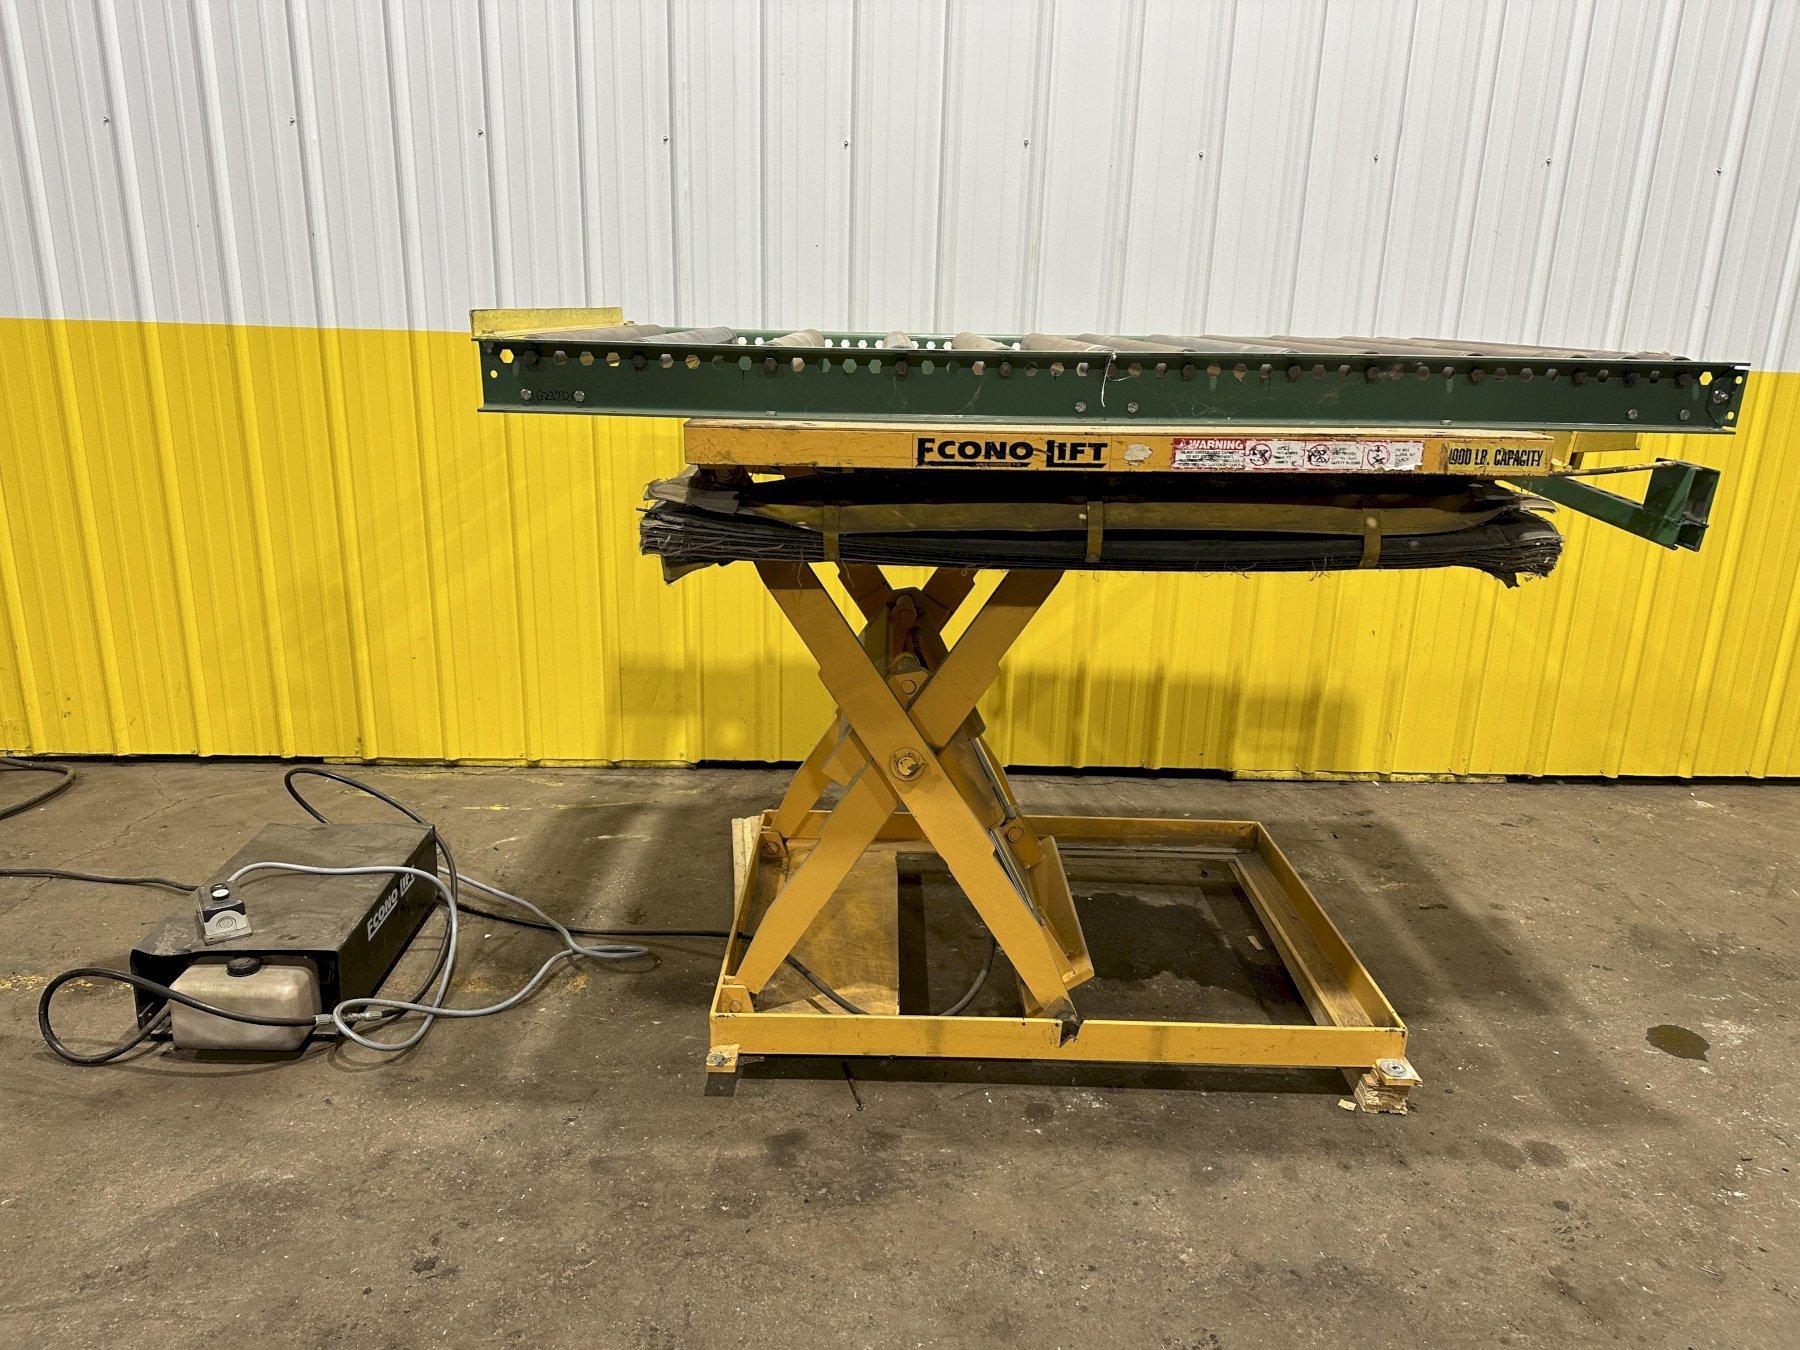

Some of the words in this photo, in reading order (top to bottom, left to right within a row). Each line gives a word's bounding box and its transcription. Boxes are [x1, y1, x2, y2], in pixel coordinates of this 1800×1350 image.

[915, 437, 1034, 468] ECONO
[1045, 439, 1109, 469] LIFT
[1187, 440, 1244, 450] WARNING
[1474, 448, 1490, 466] LB.
[1493, 448, 1544, 467] CAPACITY
[366, 888, 399, 941] ECONO
